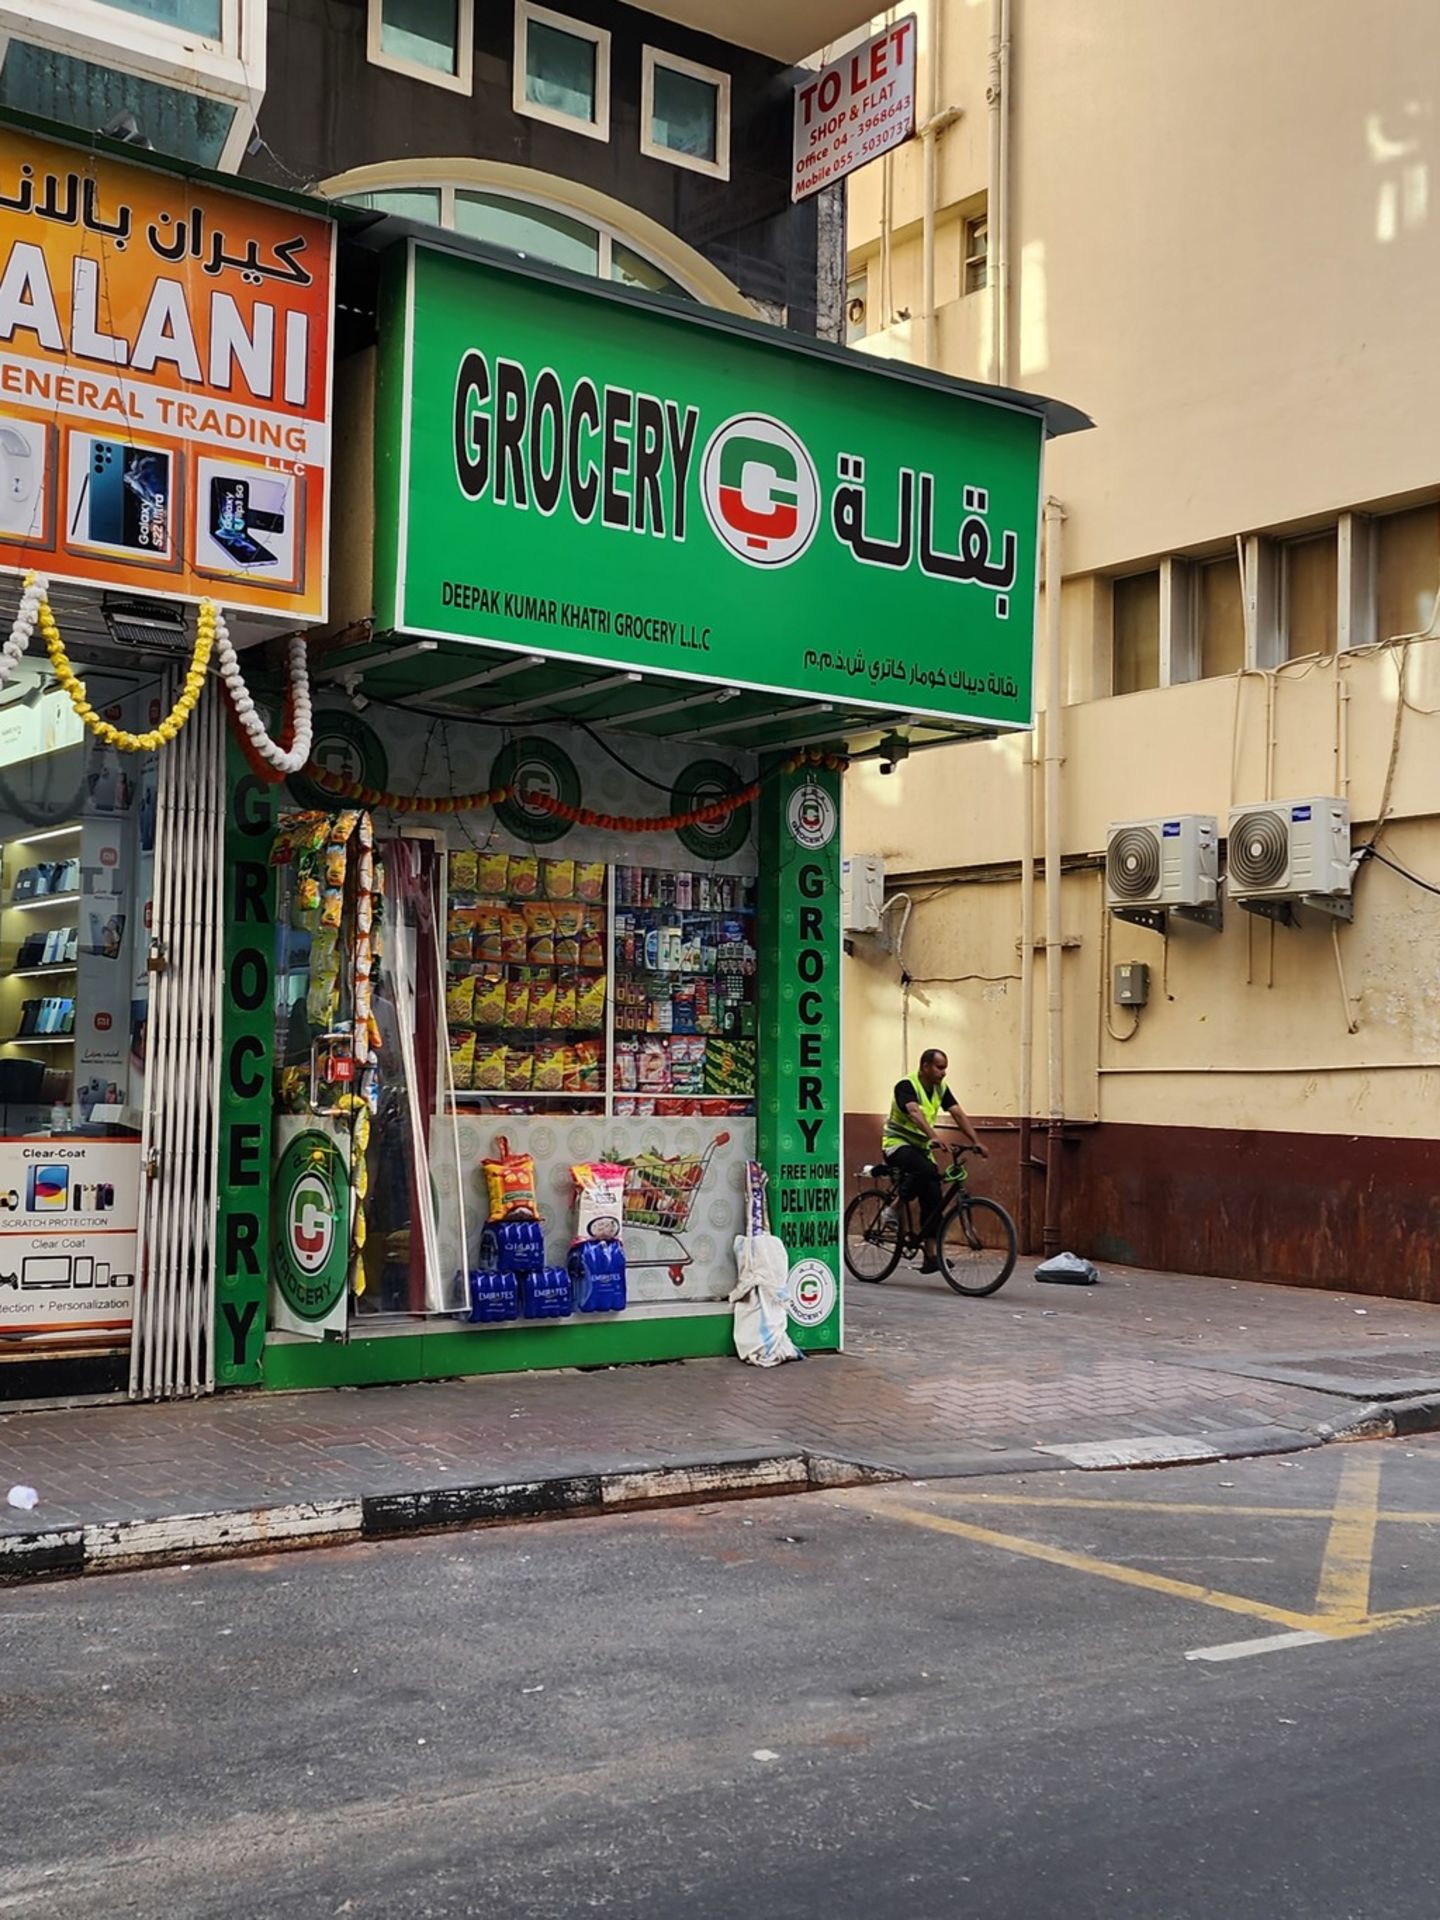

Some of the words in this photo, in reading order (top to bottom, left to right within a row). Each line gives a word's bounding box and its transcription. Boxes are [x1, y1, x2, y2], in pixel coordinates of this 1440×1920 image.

[800, 71, 841, 125] TO
[851, 23, 911, 96] LET
[809, 112, 846, 146] SHOP
[849, 105, 860, 121] &
[863, 81, 896, 114] FLAT
[796, 148, 829, 173] Office
[795, 166, 831, 194] Mobile
[147, 206, 312, 286] كيران
[156, 397, 307, 454] TRADING
[453, 347, 700, 542] GROCERY
[265, 456, 306, 476] L.L.C
[152, 493, 164, 523] Ultra
[138, 500, 151, 545] Galaxy
[152, 523, 163, 547] S22
[832, 452, 1018, 619] بقالة
[442, 581, 500, 615] DEEPAK
[504, 593, 557, 624] KUMAR
[561, 602, 610, 634] KHATRI
[614, 613, 677, 645] GROCERY
[680, 624, 711, 651] L.L.C
[868, 658, 906, 686] كاتري
[909, 663, 946, 689] كومار
[948, 670, 985, 696] ديباك
[987, 672, 1018, 702] بقالة
[797, 863, 825, 1153] GROCERY
[222, 774, 271, 1365] GROCERY
[22, 1148, 86, 1159] Clear-Coat
[781, 1164, 807, 1179] FREE
[809, 1163, 839, 1179] HOME
[781, 1188, 839, 1213] DELIVERY
[1, 1218, 47, 1228] SCRATCH
[48, 1217, 108, 1227] PROTECTION
[31, 1238, 59, 1249] Clear
[61, 1238, 85, 1249] Coat
[48, 1298, 129, 1311] Personalization
